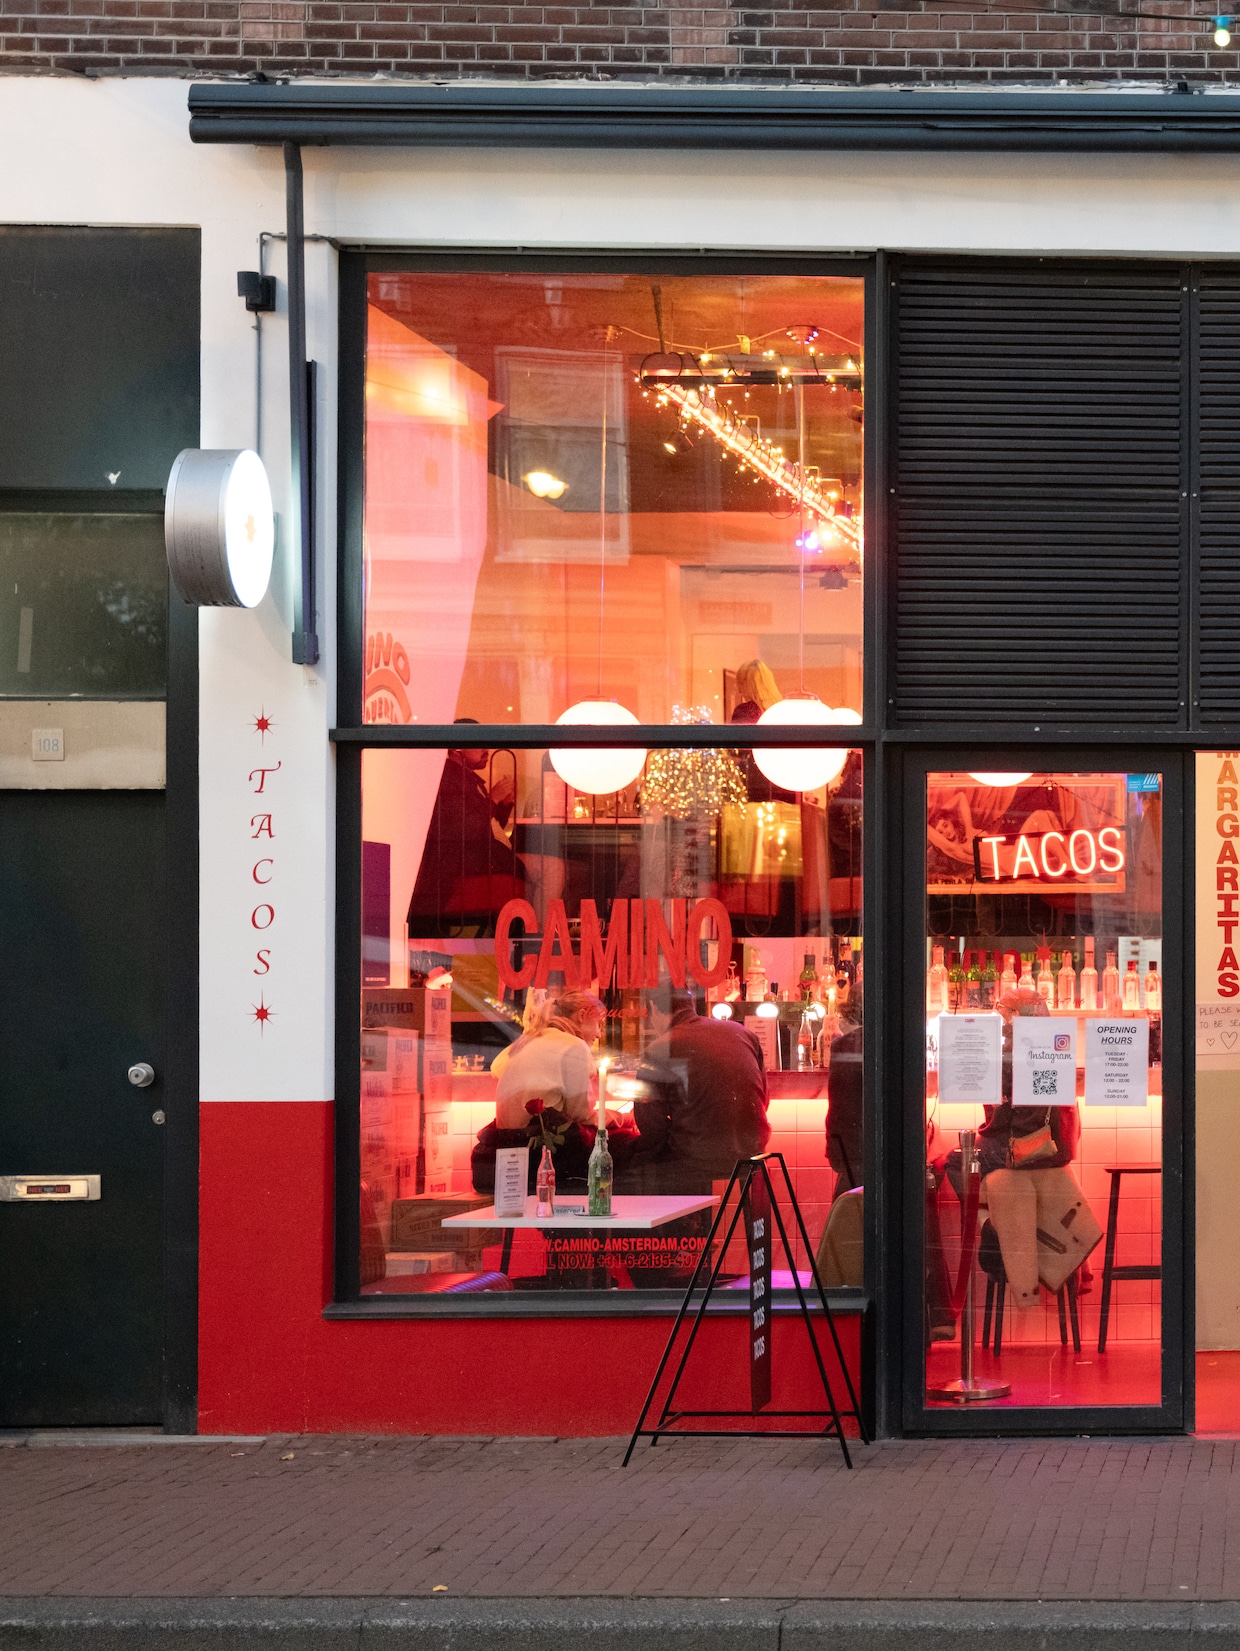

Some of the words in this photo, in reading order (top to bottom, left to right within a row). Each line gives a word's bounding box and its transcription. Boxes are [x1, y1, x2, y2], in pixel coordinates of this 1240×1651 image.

[37, 738, 59, 752] 108
[982, 827, 1124, 881] TACOS
[248, 760, 282, 976] TACOS
[1216, 752, 1240, 998] ARGARITAS
[494, 898, 733, 990] CAMINO
[365, 1001, 413, 1015] PACIFICO
[1200, 1006, 1232, 1016] PLEASE
[1097, 1026, 1137, 1034] OPENING
[1200, 1021, 1209, 1029] TO
[1101, 1036, 1133, 1045] HOURS
[1028, 1051, 1072, 1063] Instagram
[553, 1206, 580, 1214] eserved
[753, 1217, 765, 1240] TACOS
[753, 1247, 765, 1270] TACOS
[753, 1276, 765, 1300] TACOS
[753, 1306, 765, 1330] TACOS
[753, 1335, 765, 1361] TACOS
